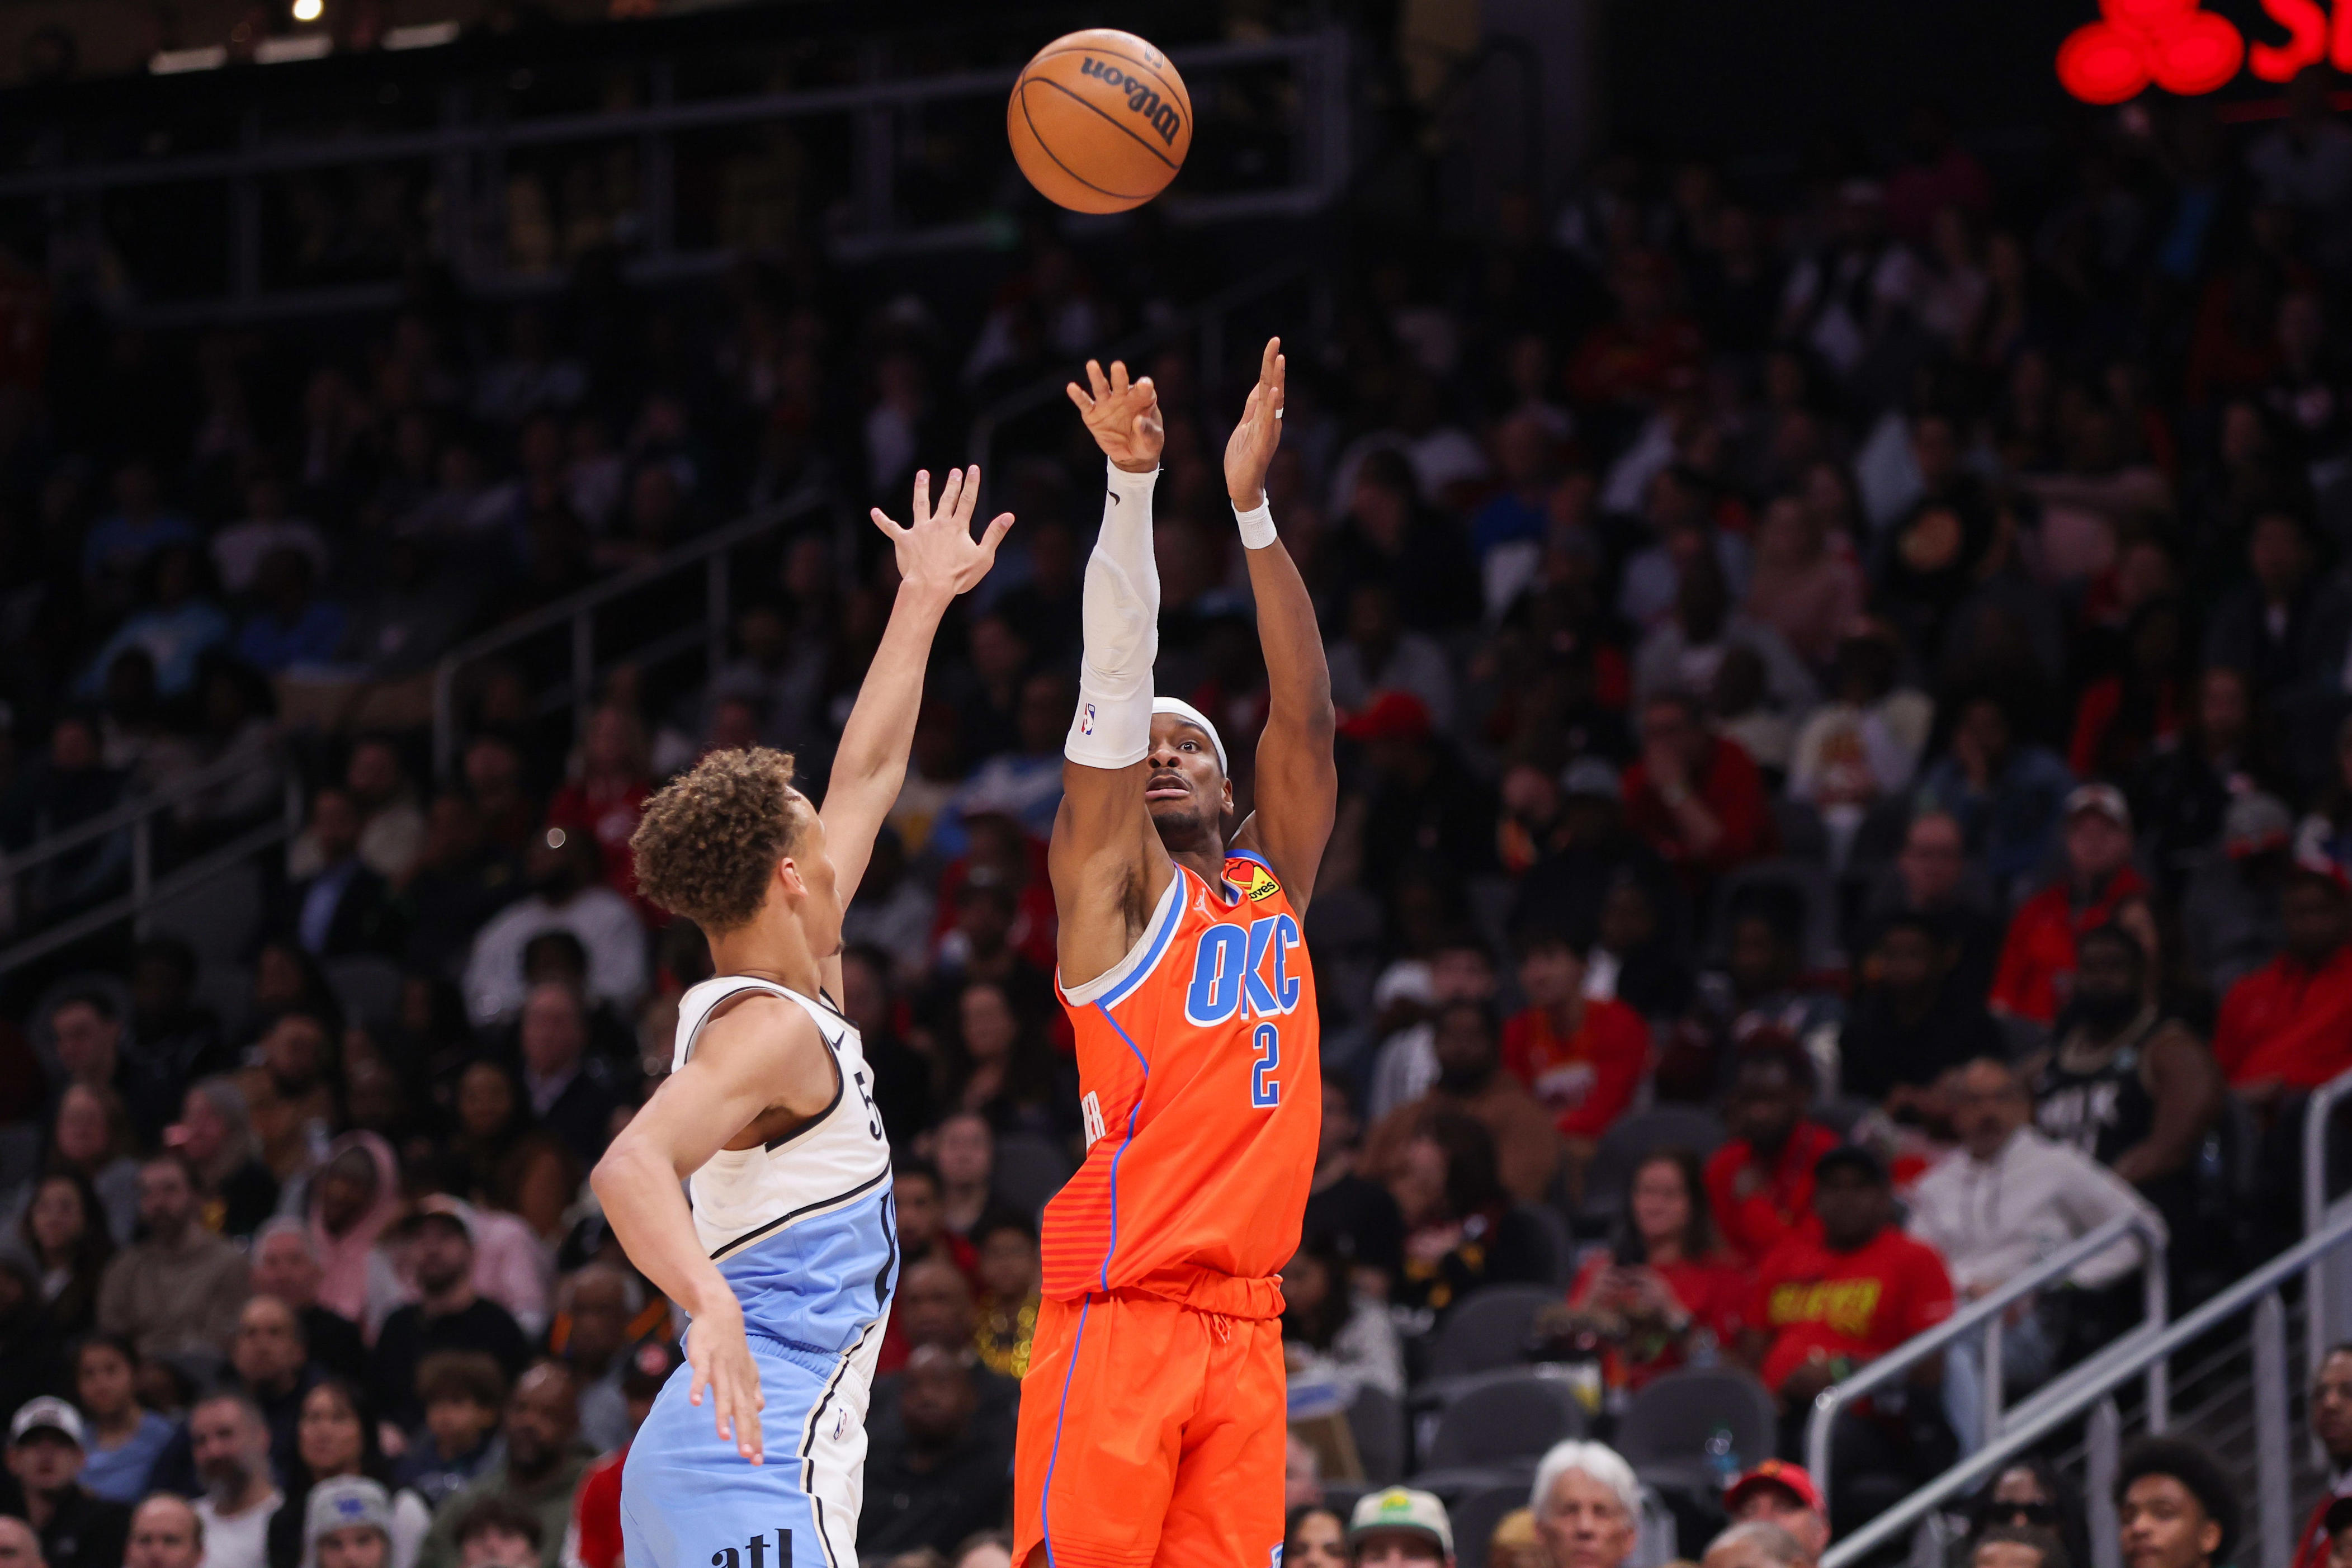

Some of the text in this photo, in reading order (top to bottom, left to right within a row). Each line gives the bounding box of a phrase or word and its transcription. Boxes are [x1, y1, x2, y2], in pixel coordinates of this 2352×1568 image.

[1081, 56, 1180, 147] Wilson
[1249, 881, 1276, 899] oves
[1184, 913, 1301, 1028] OKC
[1251, 1022, 1280, 1108] 2
[854, 1071, 882, 1141] 5
[1081, 1090, 1107, 1151] ER
[711, 1528, 793, 1568] atl
